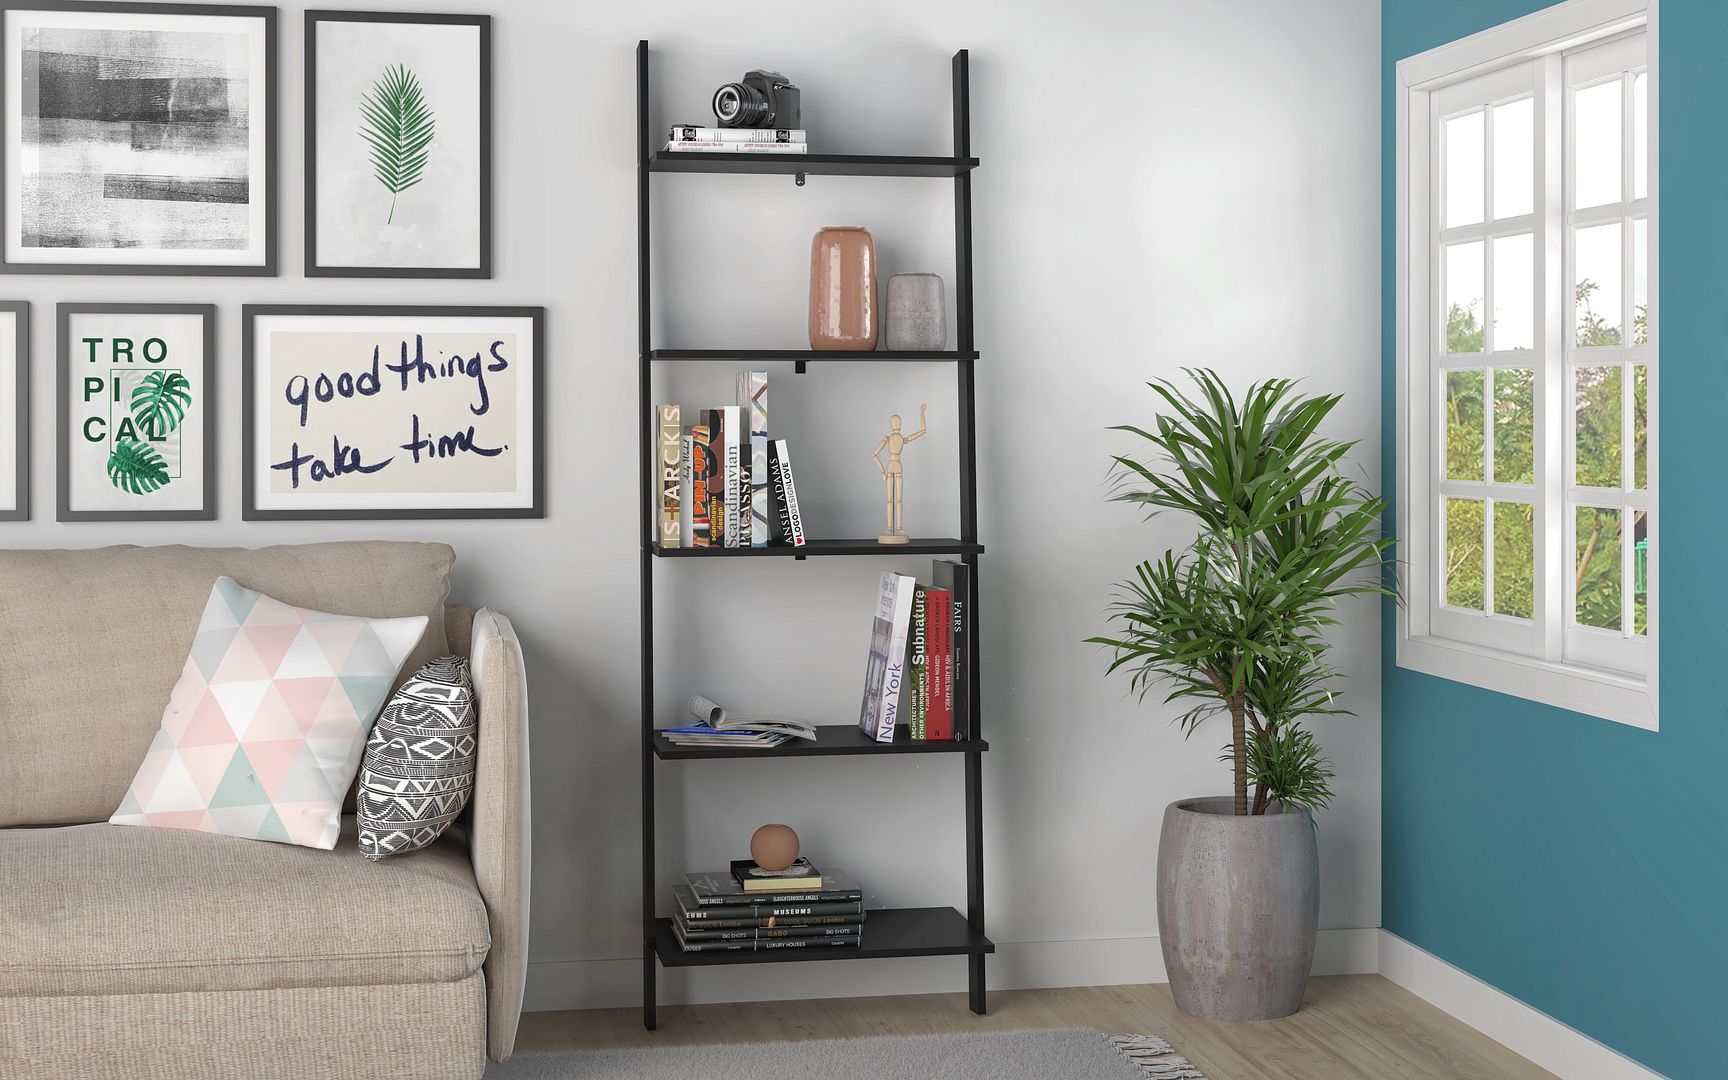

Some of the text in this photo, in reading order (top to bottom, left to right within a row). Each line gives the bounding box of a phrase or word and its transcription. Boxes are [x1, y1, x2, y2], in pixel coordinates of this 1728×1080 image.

[82, 337, 168, 363] TRO
[285, 334, 509, 427] good things
[84, 377, 120, 402] PI
[83, 416, 167, 442] CAL
[270, 434, 395, 489] take
[694, 444, 706, 515] PIN-UP
[725, 446, 738, 548] Scandinavian
[739, 470, 751, 547] PICASSO
[769, 457, 793, 544] ANSEL ADAMS
[912, 590, 925, 665] Subnature
[954, 601, 962, 633] FAIRS
[880, 663, 902, 740] New York
